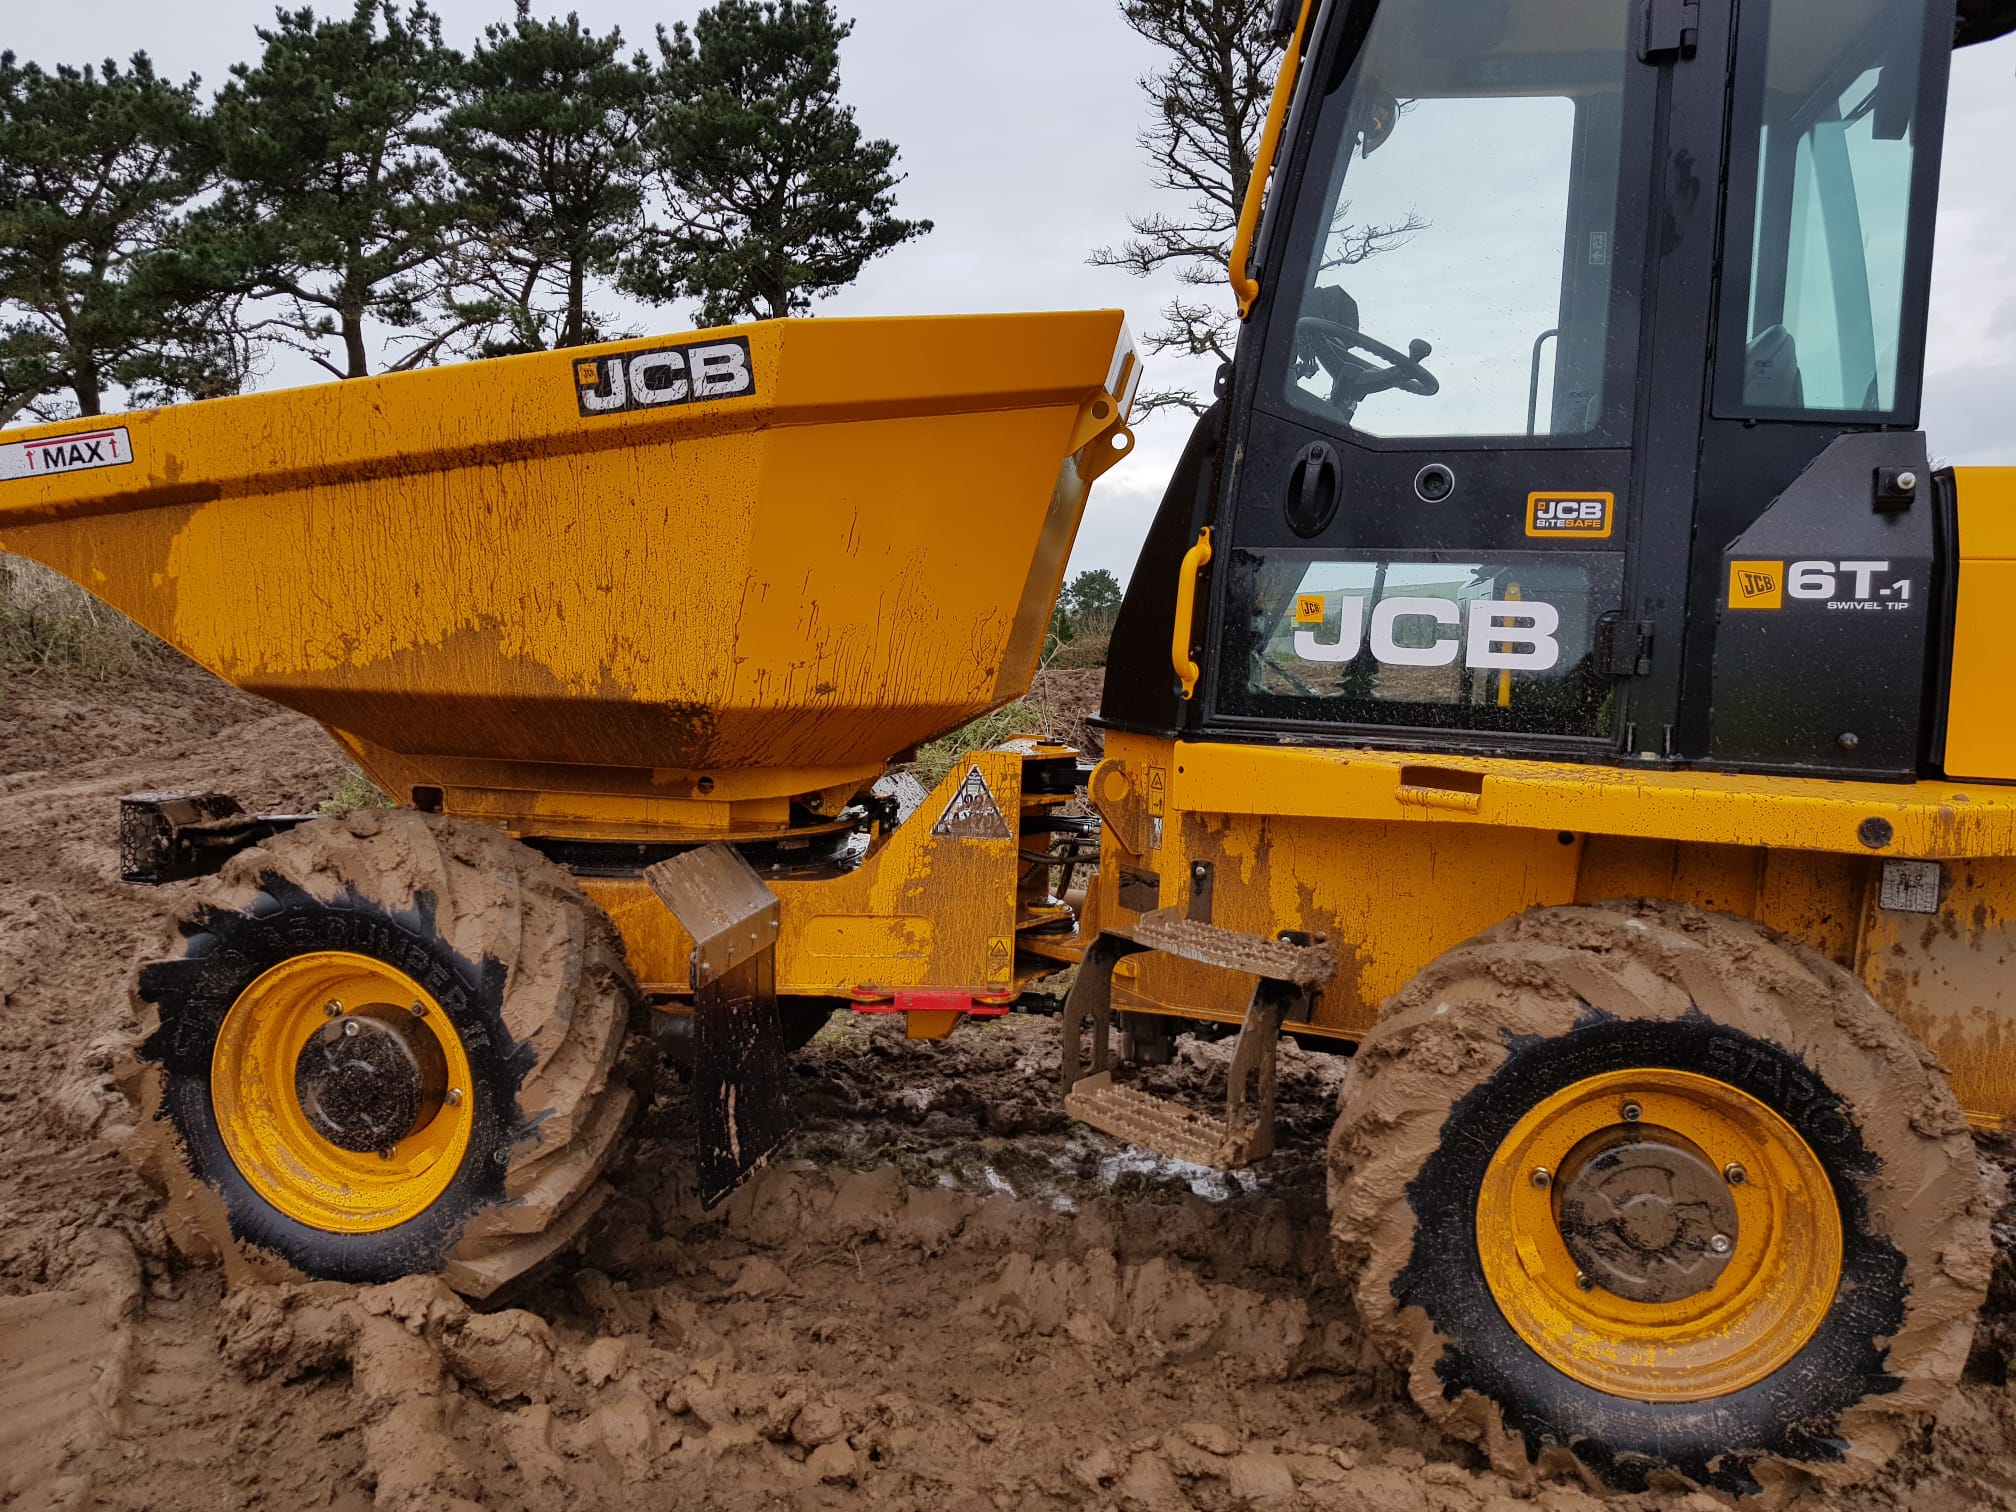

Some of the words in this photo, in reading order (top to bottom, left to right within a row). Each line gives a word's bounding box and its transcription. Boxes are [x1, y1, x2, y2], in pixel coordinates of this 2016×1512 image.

[582, 343, 750, 411] JCB
[42, 440, 105, 469] MAX
[1537, 501, 1602, 519] JCB
[1743, 573, 1774, 596] JCB
[1304, 601, 1321, 615] JCB
[1827, 601, 1881, 610] SWIVEL
[1886, 602, 1908, 611] TIP
[1293, 595, 1560, 671] JCB
